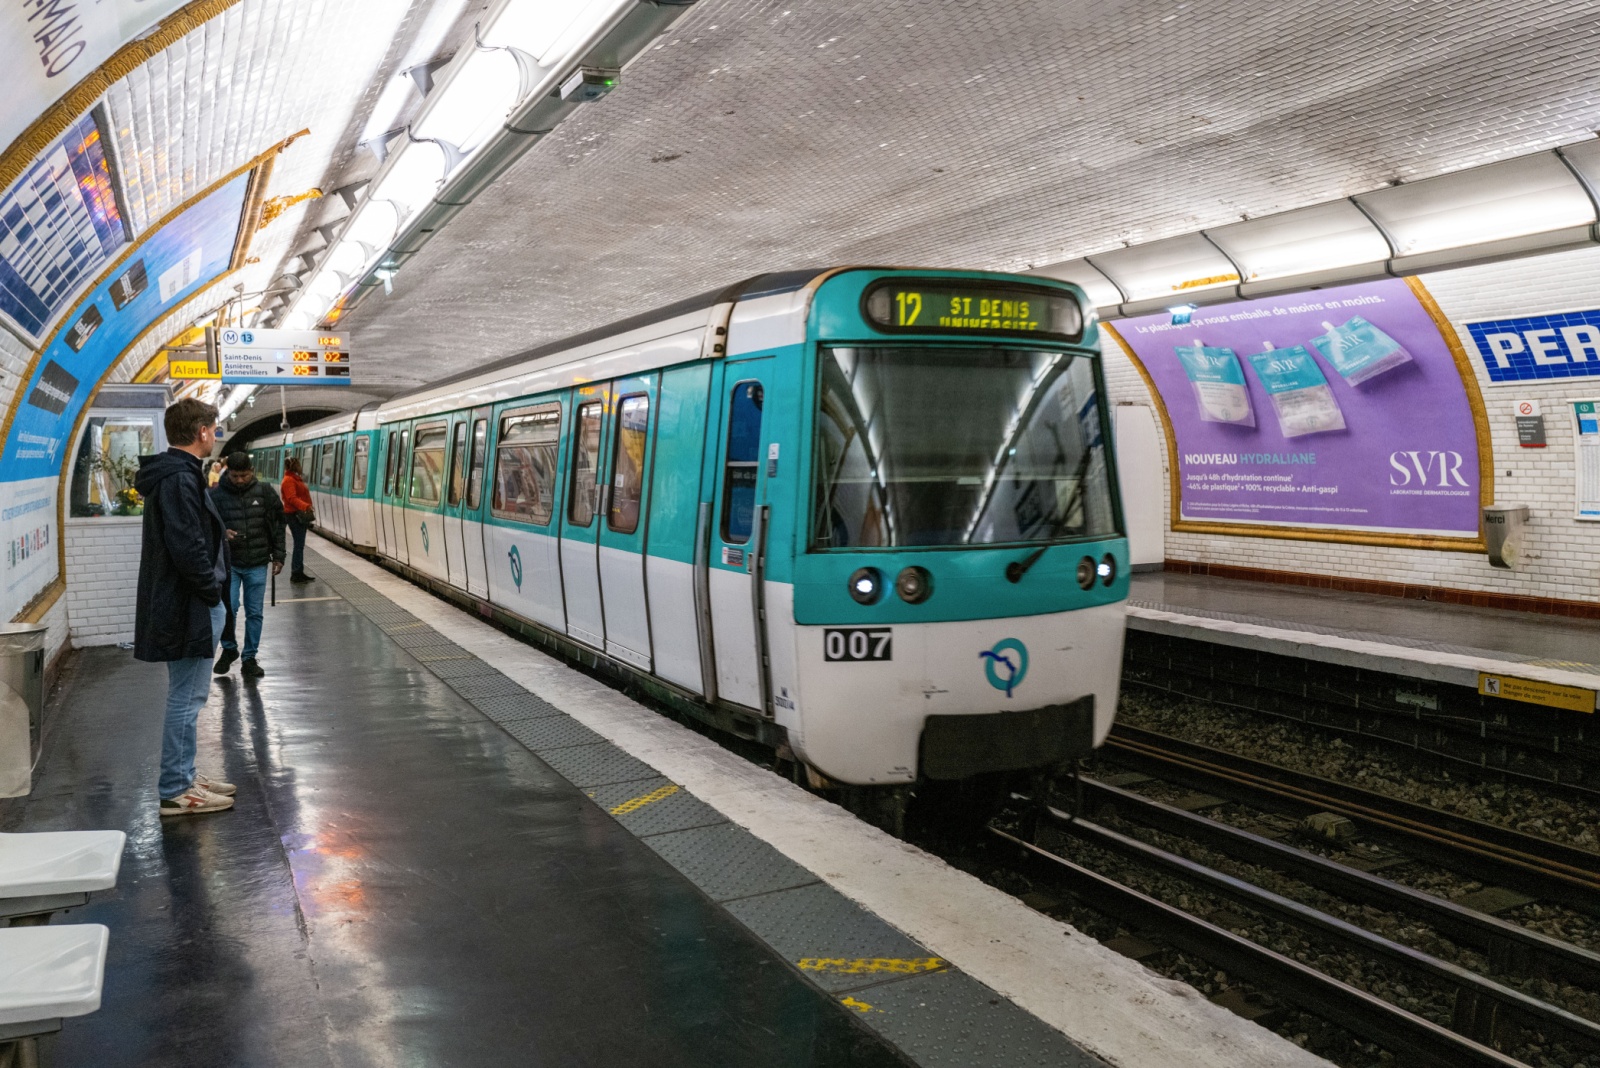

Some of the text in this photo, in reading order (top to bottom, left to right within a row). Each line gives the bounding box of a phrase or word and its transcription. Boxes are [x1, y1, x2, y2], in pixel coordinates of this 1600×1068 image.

[950, 297, 1030, 318] ST DENIS
[1135, 325, 1147, 334] Le
[1204, 315, 1229, 325] nous
[1230, 308, 1272, 322] emballe
[1272, 305, 1288, 316] de
[1289, 302, 1324, 315] moins
[1326, 300, 1340, 309] en
[1341, 293, 1386, 307] moins.
[241, 334, 253, 343] 13
[1485, 324, 1600, 368] PER
[324, 352, 340, 362] 02
[174, 364, 208, 375] Alarm
[293, 365, 309, 376] 05
[1271, 359, 1298, 373] SVR
[1185, 453, 1317, 465] NOUVEAU HYDRALIANE
[1389, 450, 1470, 487] SVR
[1208, 473, 1220, 481] 48h
[1263, 485, 1296, 493] recyclable
[1301, 485, 1339, 494] Anti-gaspi
[1485, 514, 1505, 524] Merci
[826, 631, 893, 659] 007
[1503, 689, 1523, 697] Danger
[1523, 686, 1551, 695] descendre
